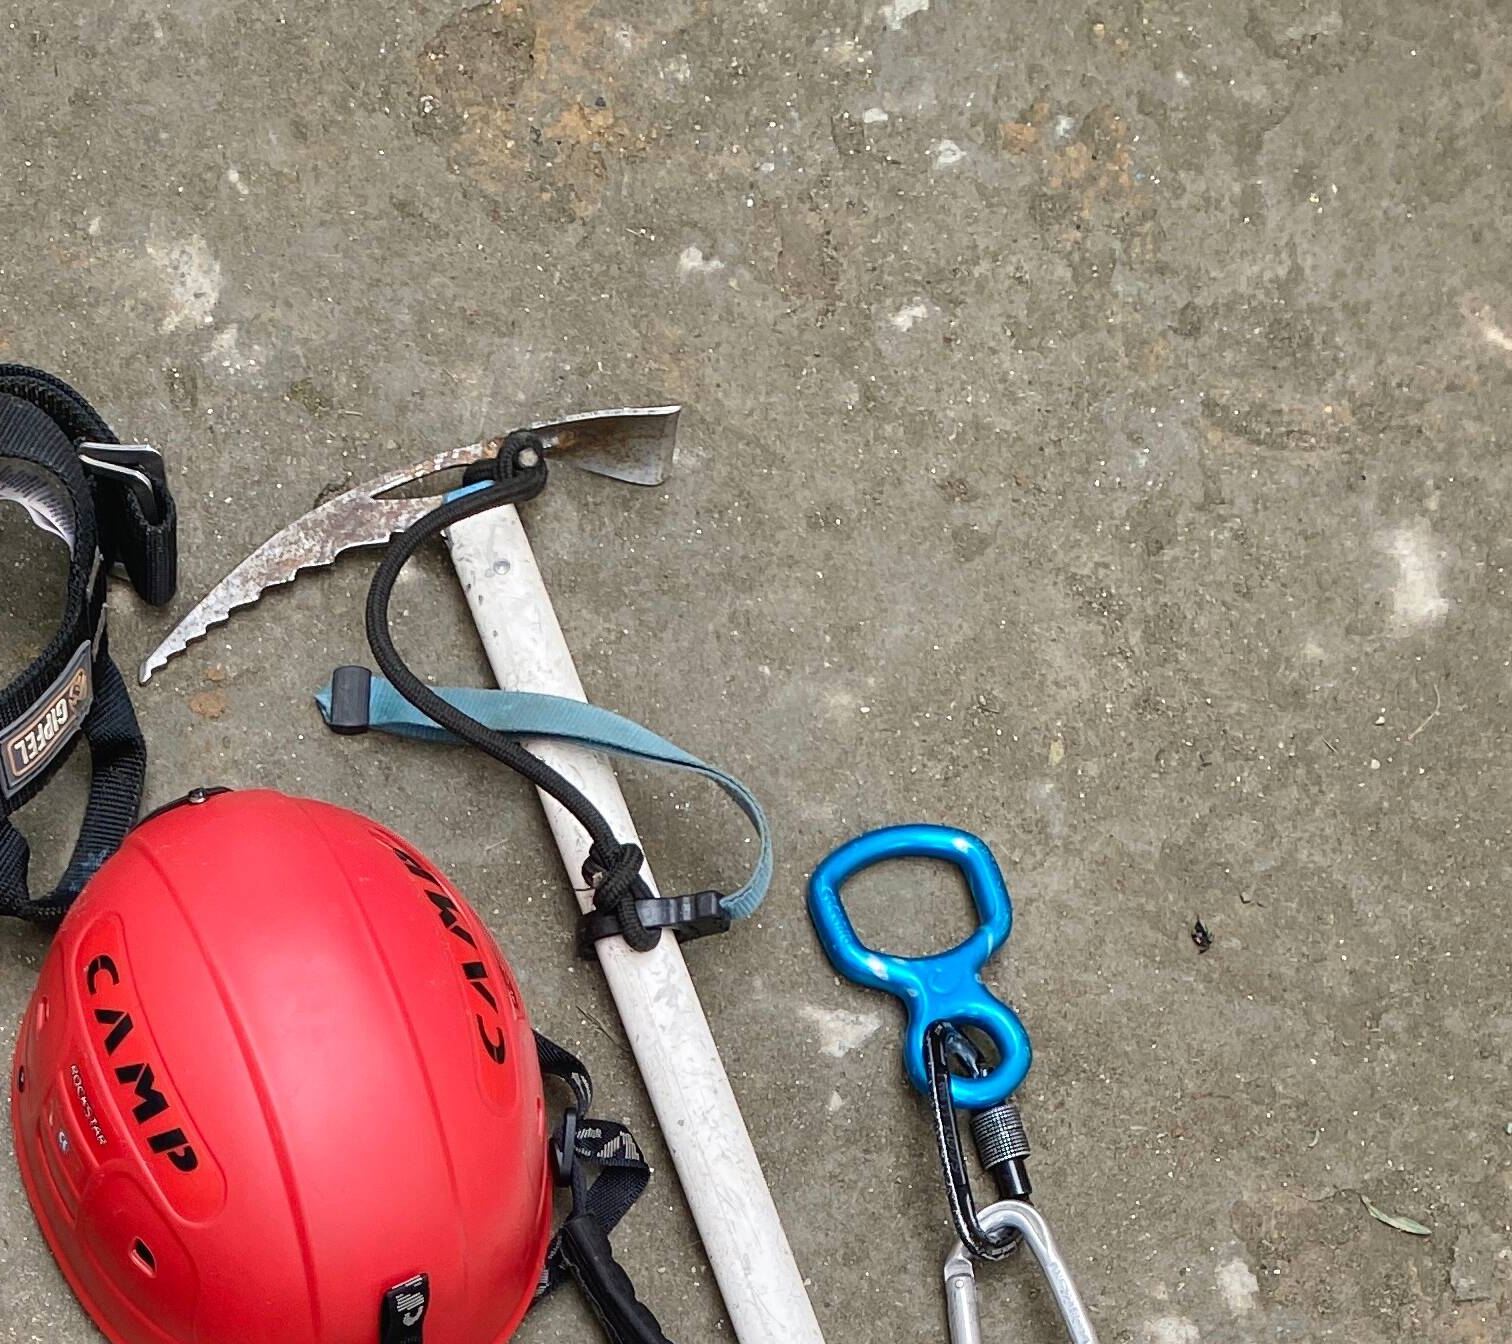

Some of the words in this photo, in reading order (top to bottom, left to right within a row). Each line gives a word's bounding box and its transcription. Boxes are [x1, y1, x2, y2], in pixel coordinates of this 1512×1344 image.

[13, 697, 69, 766] GIPFEL
[87, 954, 199, 1173] CAMP
[71, 1064, 108, 1145] ROCKSTAR
